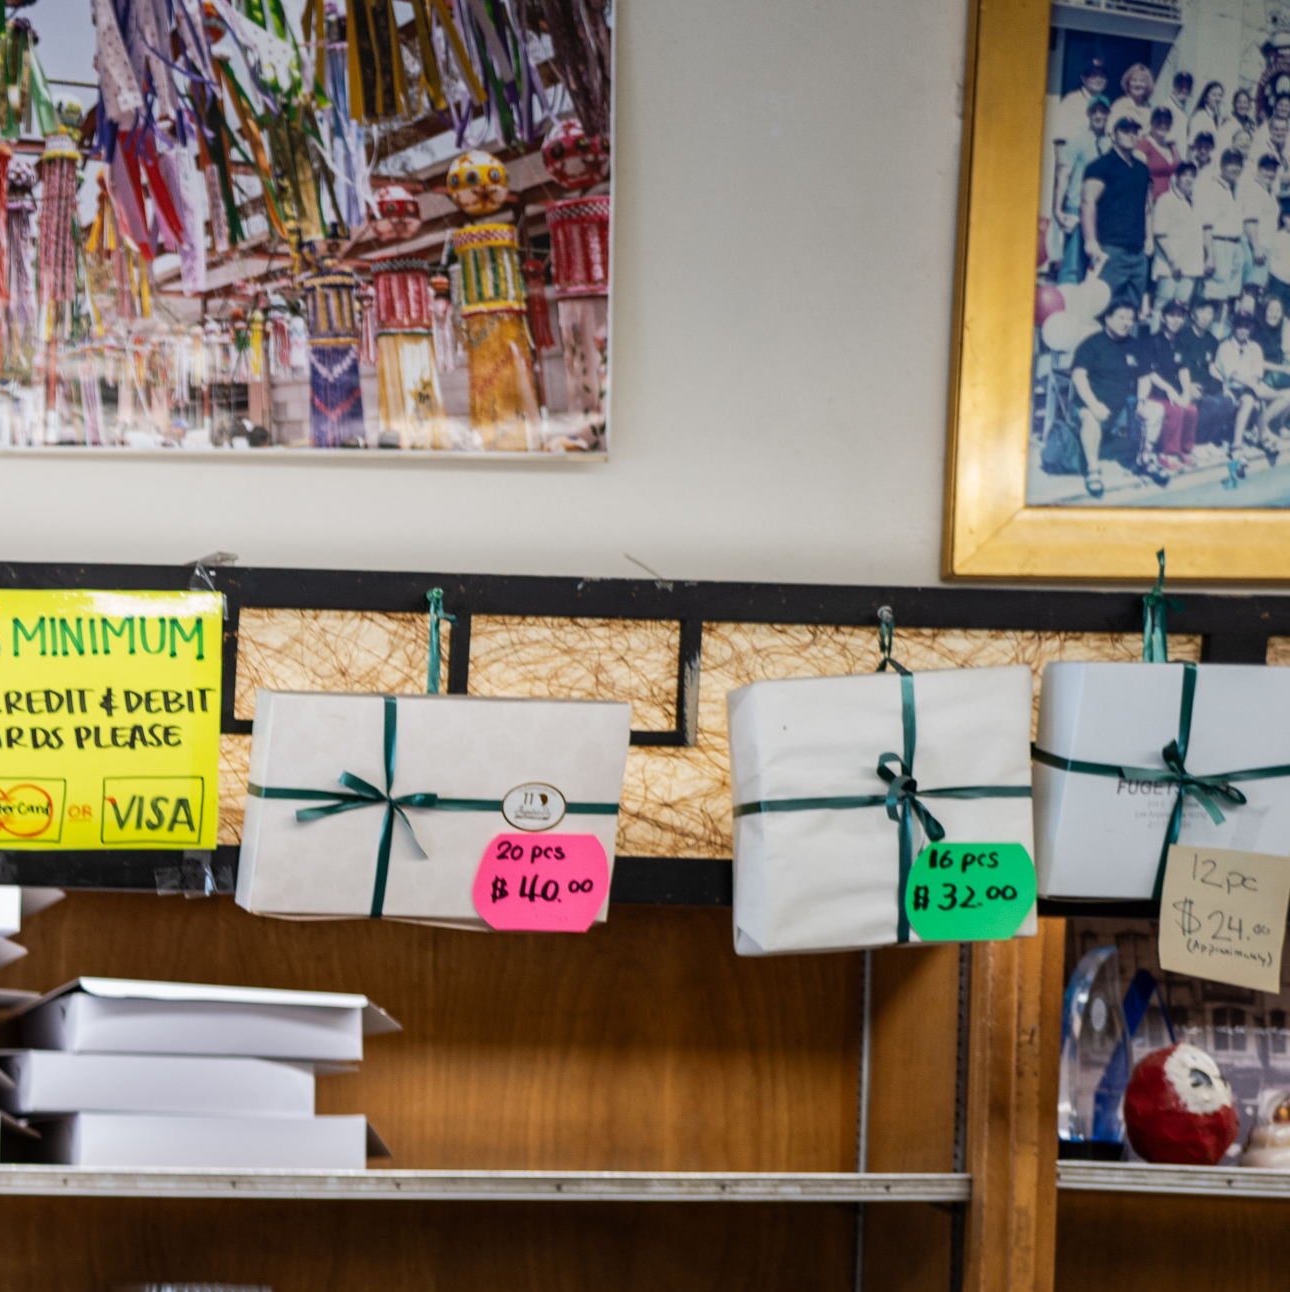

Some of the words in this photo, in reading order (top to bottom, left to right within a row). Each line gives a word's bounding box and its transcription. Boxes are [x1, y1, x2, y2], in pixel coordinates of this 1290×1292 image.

[12, 615, 205, 661] MINIMUM
[99, 686, 120, 717] &
[124, 688, 216, 714] DEBIT
[75, 724, 182, 749] PLEASE
[67, 804, 94, 819] OR
[105, 795, 195, 832] VISA
[496, 841, 524, 860] 20
[530, 845, 566, 864] pcs
[928, 848, 953, 869] 16
[961, 850, 1000, 870] pcs
